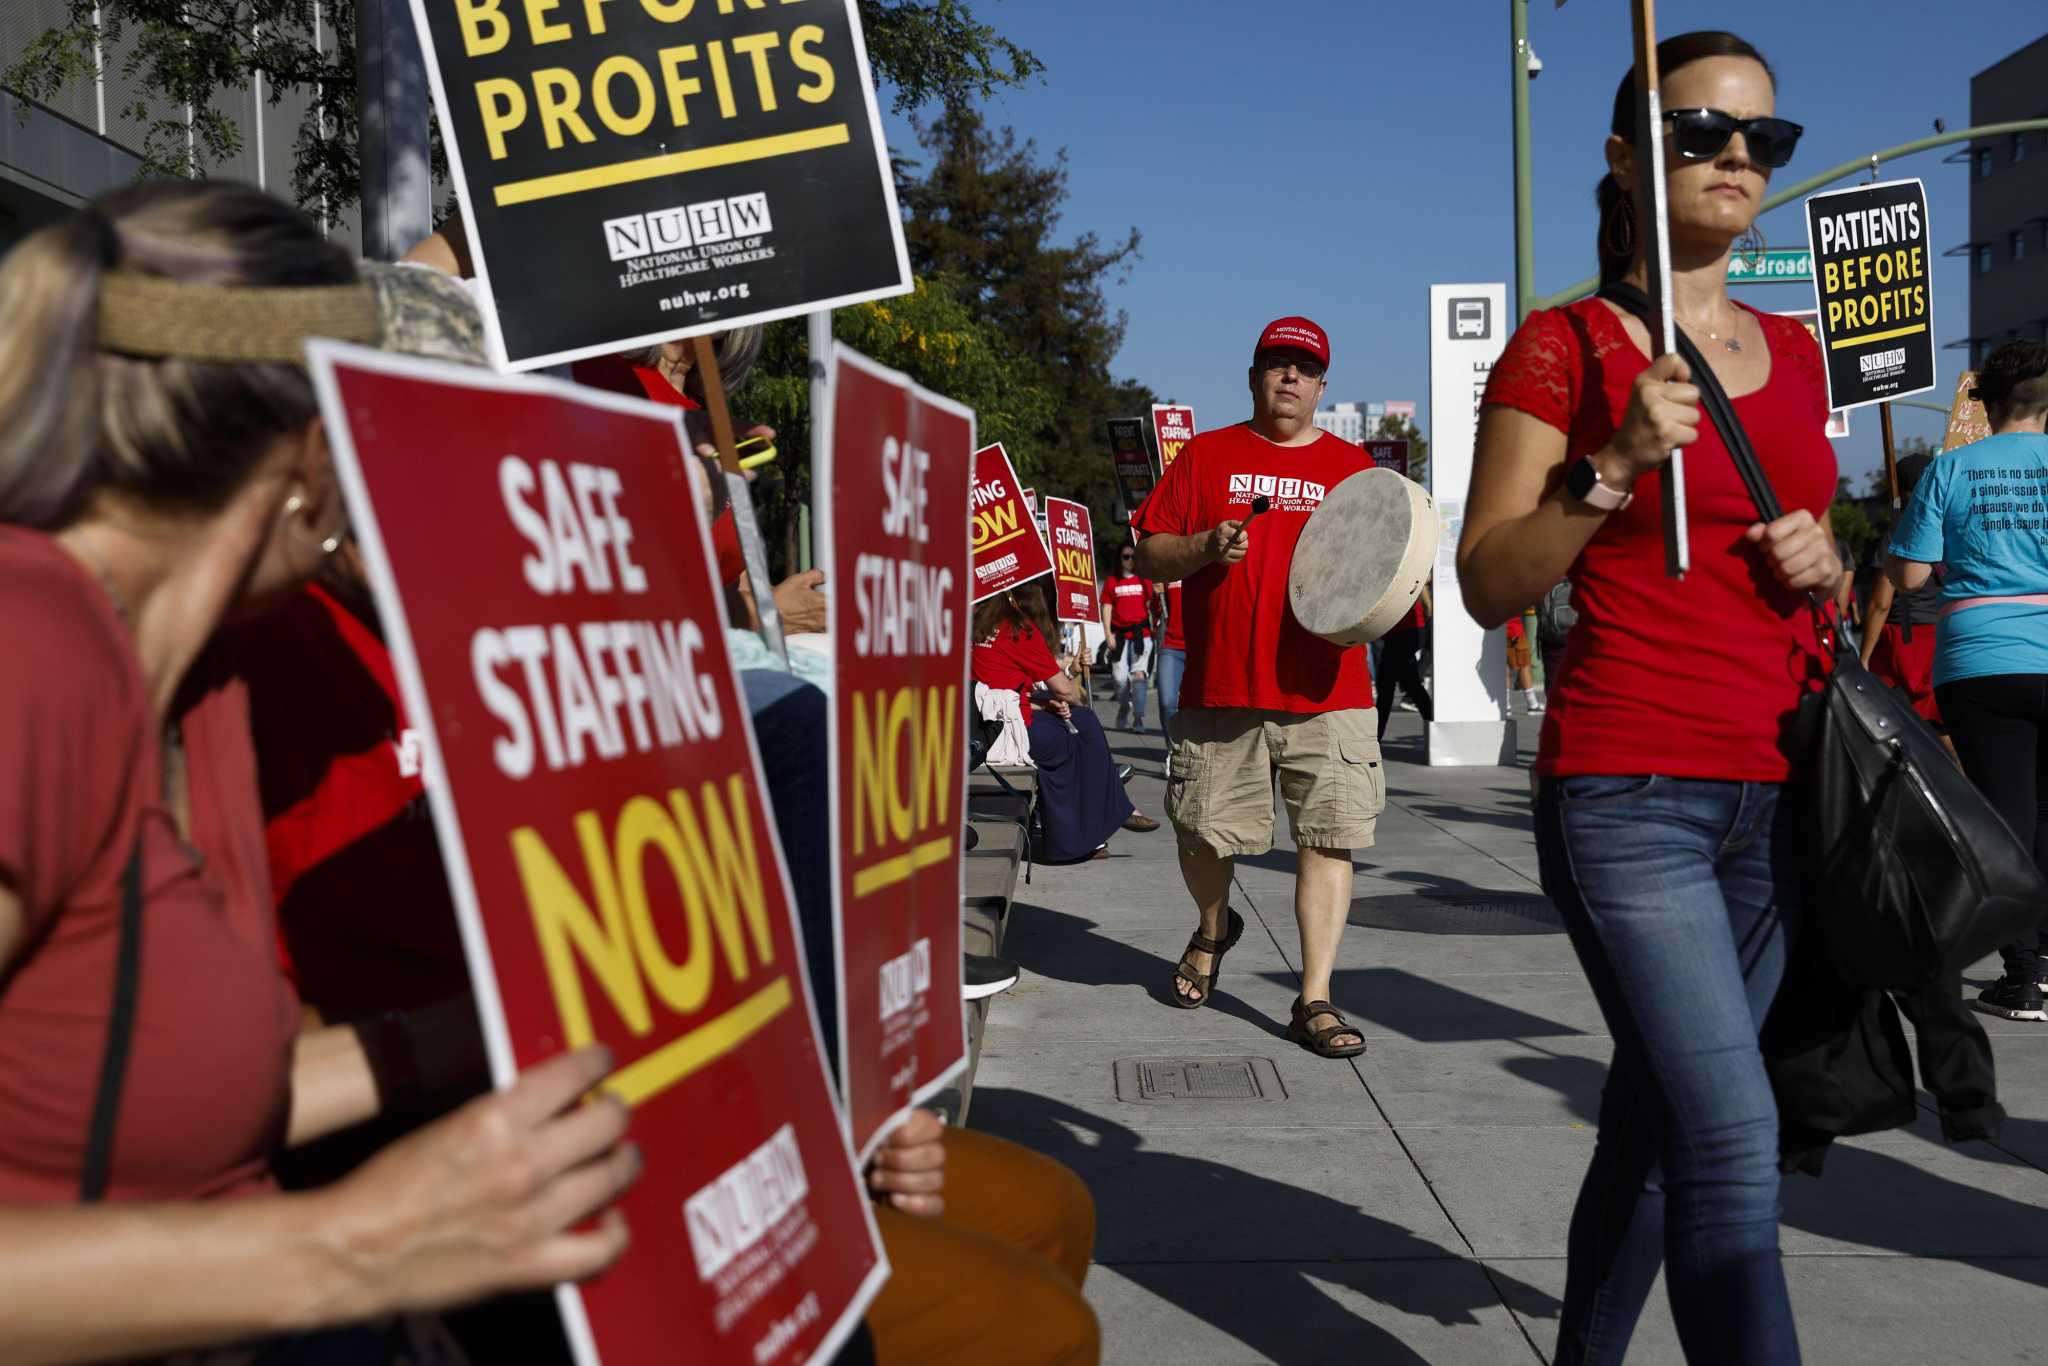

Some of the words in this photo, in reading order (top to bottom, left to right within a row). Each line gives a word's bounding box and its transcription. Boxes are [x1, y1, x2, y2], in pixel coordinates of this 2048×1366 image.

[474, 24, 837, 160] PROFITS
[606, 194, 769, 258] NUHW
[1819, 201, 1921, 255] PATIENTS
[618, 259, 710, 288] HEALTHCARE
[712, 247, 776, 269] WORKERS
[627, 250, 697, 273] NATIONAL
[699, 241, 743, 259] UNION
[744, 236, 763, 250] OF
[1824, 246, 1923, 294] BEFORE
[659, 283, 750, 311] nuhw.org
[1828, 285, 1925, 333] PROFITS
[1860, 348, 1905, 372] NUHW
[1161, 426, 1191, 440] STAFFING
[1166, 413, 1183, 426] SAFE
[1162, 441, 1184, 461] NO
[1231, 475, 1323, 499] NUHW
[1998, 467, 2007, 479] is
[2009, 469, 2022, 480] no
[2024, 466, 2048, 480] such
[1229, 498, 1280, 510] HEALRE
[1235, 491, 1275, 504] NATIOL
[1277, 497, 1302, 505] UNION
[1971, 487, 1977, 498] a
[1979, 483, 2038, 498] single-issue
[971, 499, 1018, 546] OW
[1063, 509, 1079, 529] SAFE
[1972, 502, 2013, 515] because
[2015, 503, 2029, 513] we
[2032, 500, 2044, 513] do
[499, 455, 649, 596] SAFE
[1981, 517, 2040, 532] single-issue
[1057, 548, 1091, 579] NOW
[854, 552, 953, 657] STAFING
[471, 618, 723, 780] STAFFING
[852, 685, 955, 856] NOW
[510, 773, 775, 1052] NOW
